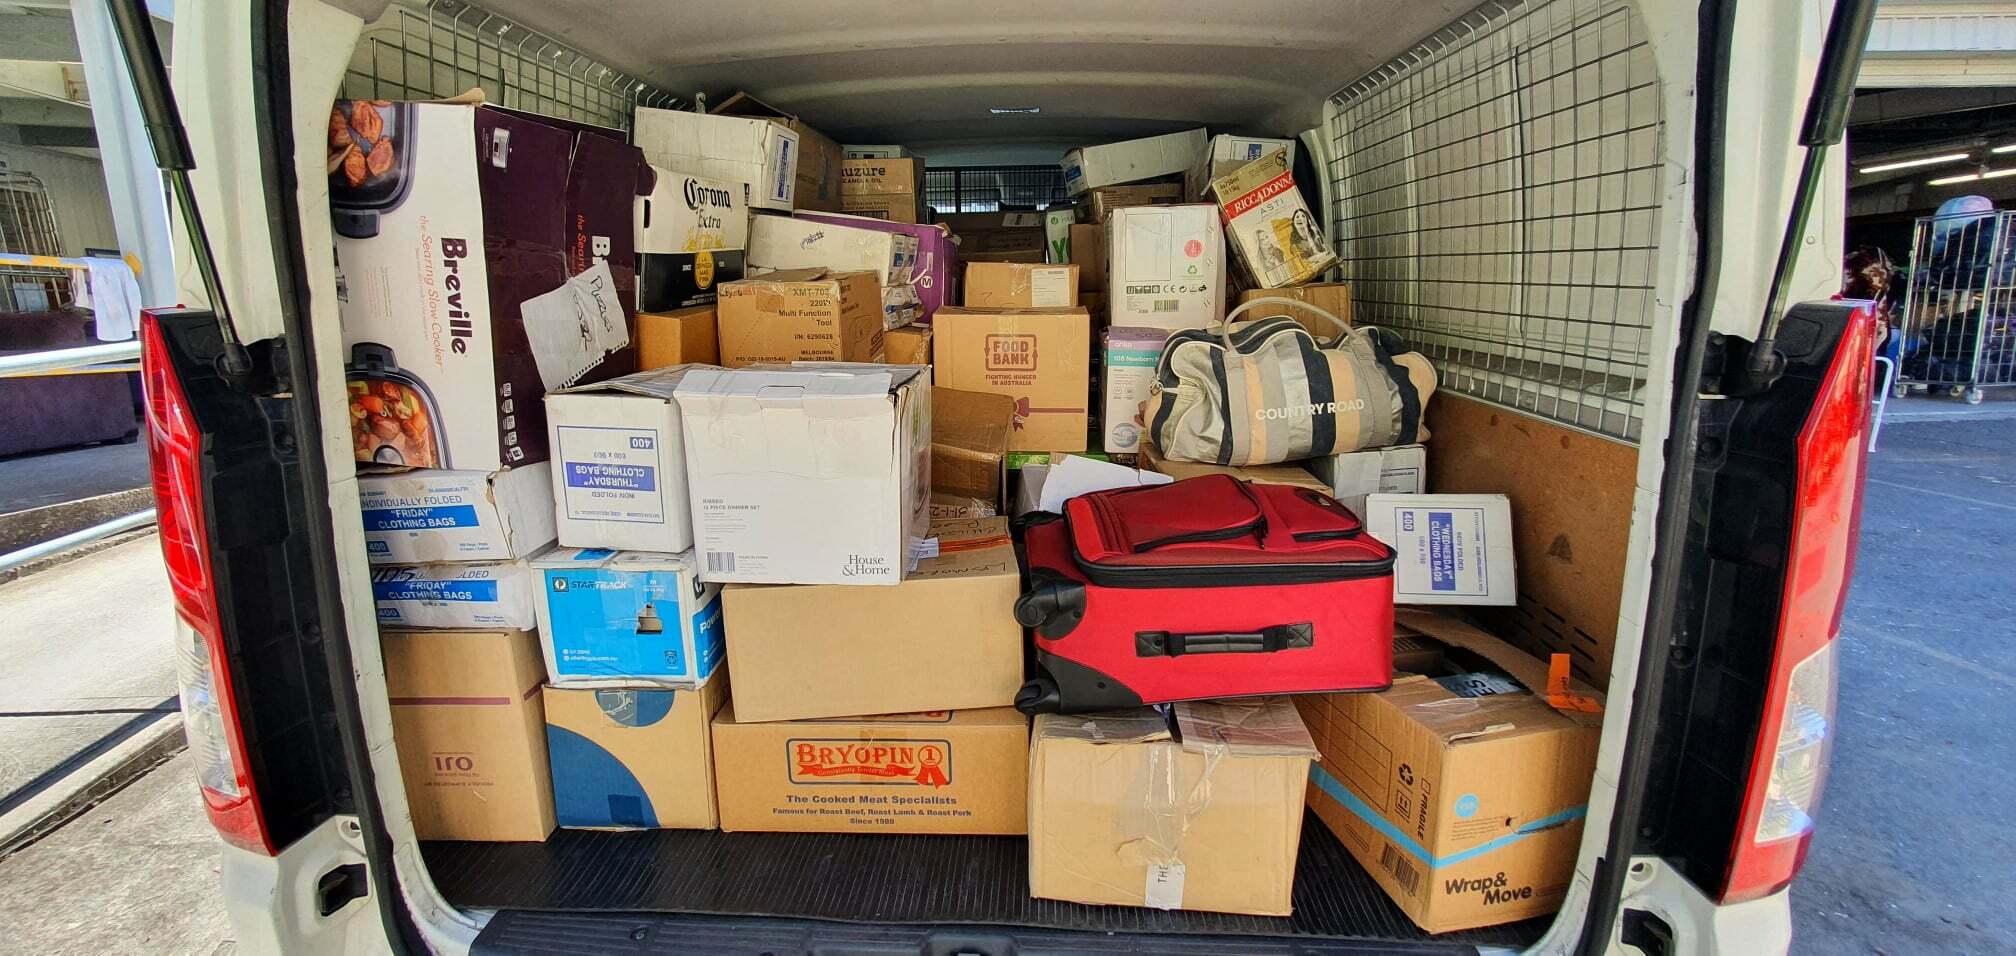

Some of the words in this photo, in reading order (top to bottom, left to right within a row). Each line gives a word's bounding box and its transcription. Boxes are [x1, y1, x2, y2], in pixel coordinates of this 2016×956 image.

[684, 177, 731, 211] Corona
[421, 233, 437, 286] Searing
[428, 288, 440, 320] Slow
[441, 237, 473, 355] Breville
[778, 309, 797, 317] Multi
[431, 322, 444, 368] Cooker
[993, 341, 1029, 352] FOOD
[993, 353, 1029, 365] BANK
[1255, 402, 1325, 420] COUNTRY
[1327, 398, 1365, 414] ROAD
[632, 438, 651, 447] 400
[575, 465, 600, 474] BAGS
[602, 467, 645, 477] CLOTHING
[424, 495, 462, 505] FOLDED
[378, 518, 427, 529] CLOTHING
[428, 517, 456, 527] BAGS
[1403, 512, 1413, 530] 400
[368, 542, 386, 552] 400
[1431, 520, 1441, 558] CLOTHING
[848, 554, 884, 565] House
[1433, 560, 1442, 582] BAGS
[388, 591, 441, 599] CLOTHING
[443, 592, 472, 600] BAGS
[797, 743, 914, 765] BRYOPIN
[786, 795, 808, 804] The
[812, 795, 855, 804] Cooked
[859, 796, 888, 804] Meat
[891, 796, 957, 805] Specialists
[1417, 793, 1428, 841] FRAGILE
[1158, 864, 1169, 883] THE
[1483, 885, 1532, 905] Move
